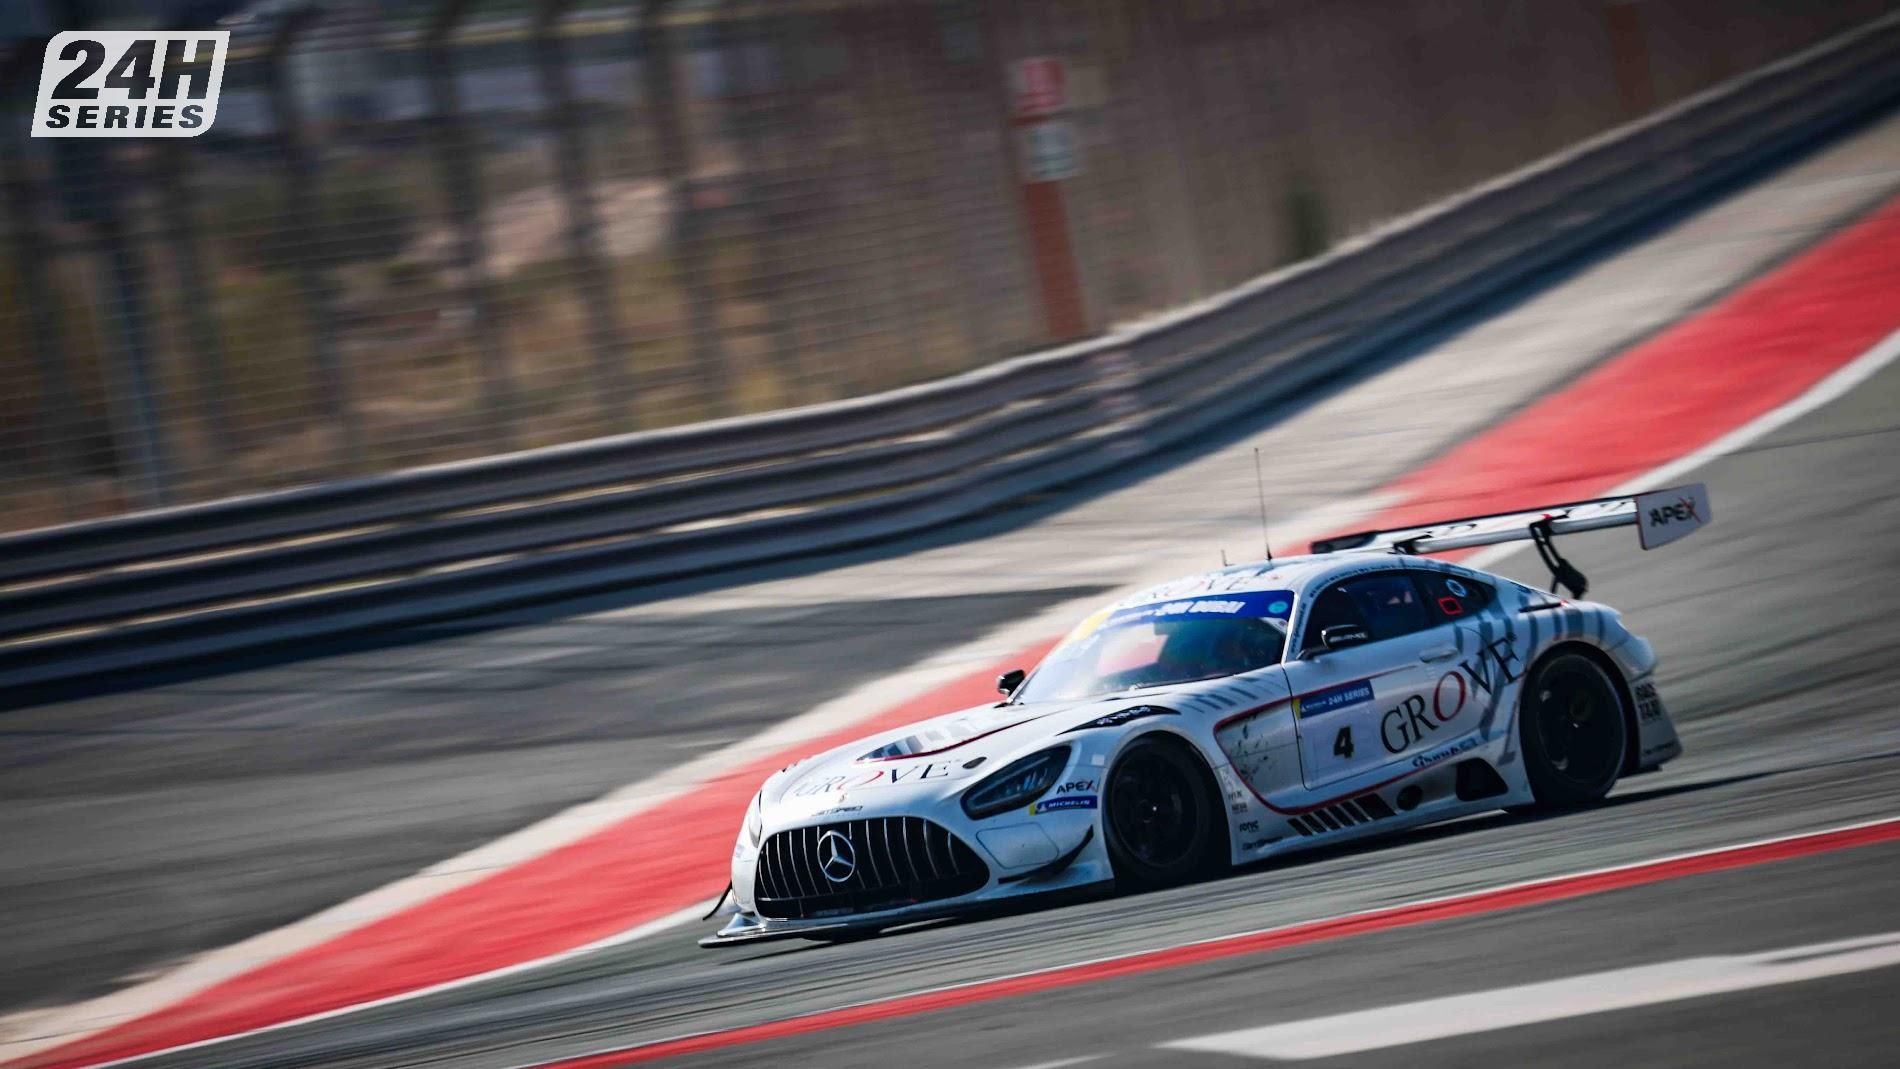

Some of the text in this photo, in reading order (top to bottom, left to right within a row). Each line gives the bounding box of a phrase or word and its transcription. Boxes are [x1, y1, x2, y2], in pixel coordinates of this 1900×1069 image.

[1648, 496, 1702, 528] APEX
[1343, 687, 1370, 701] SERIES
[1380, 632, 1523, 754] GROVE
[1333, 725, 1355, 759] 4
[1056, 779, 1101, 794] APEX
[1048, 799, 1091, 808] MICHELIN
